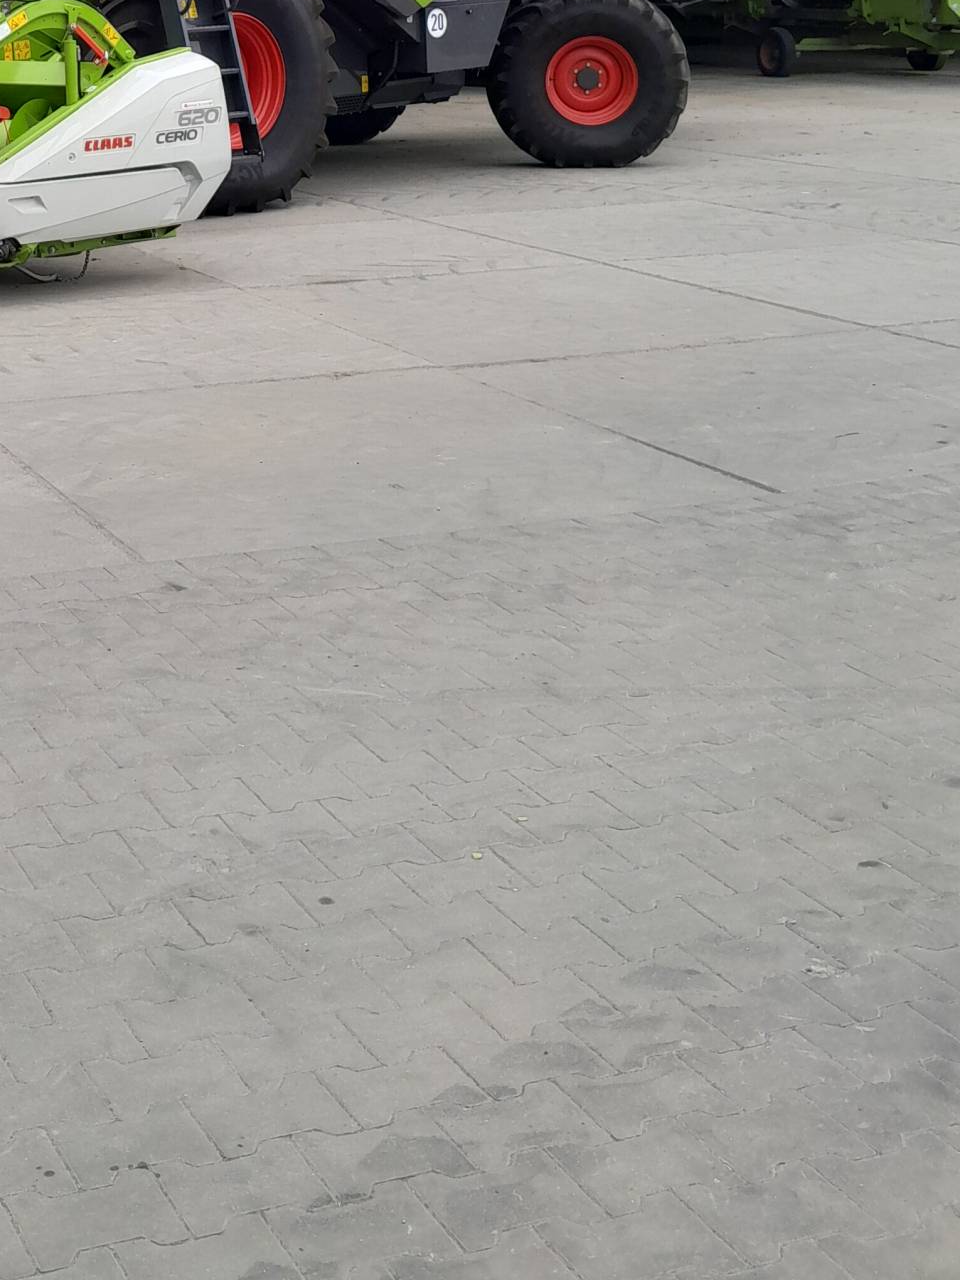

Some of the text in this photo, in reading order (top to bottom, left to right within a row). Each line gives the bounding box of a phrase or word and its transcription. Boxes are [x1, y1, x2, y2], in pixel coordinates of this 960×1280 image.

[430, 12, 444, 32] 20
[177, 107, 220, 127] 620
[83, 135, 134, 153] CLAAS
[155, 128, 198, 145] CERIO
